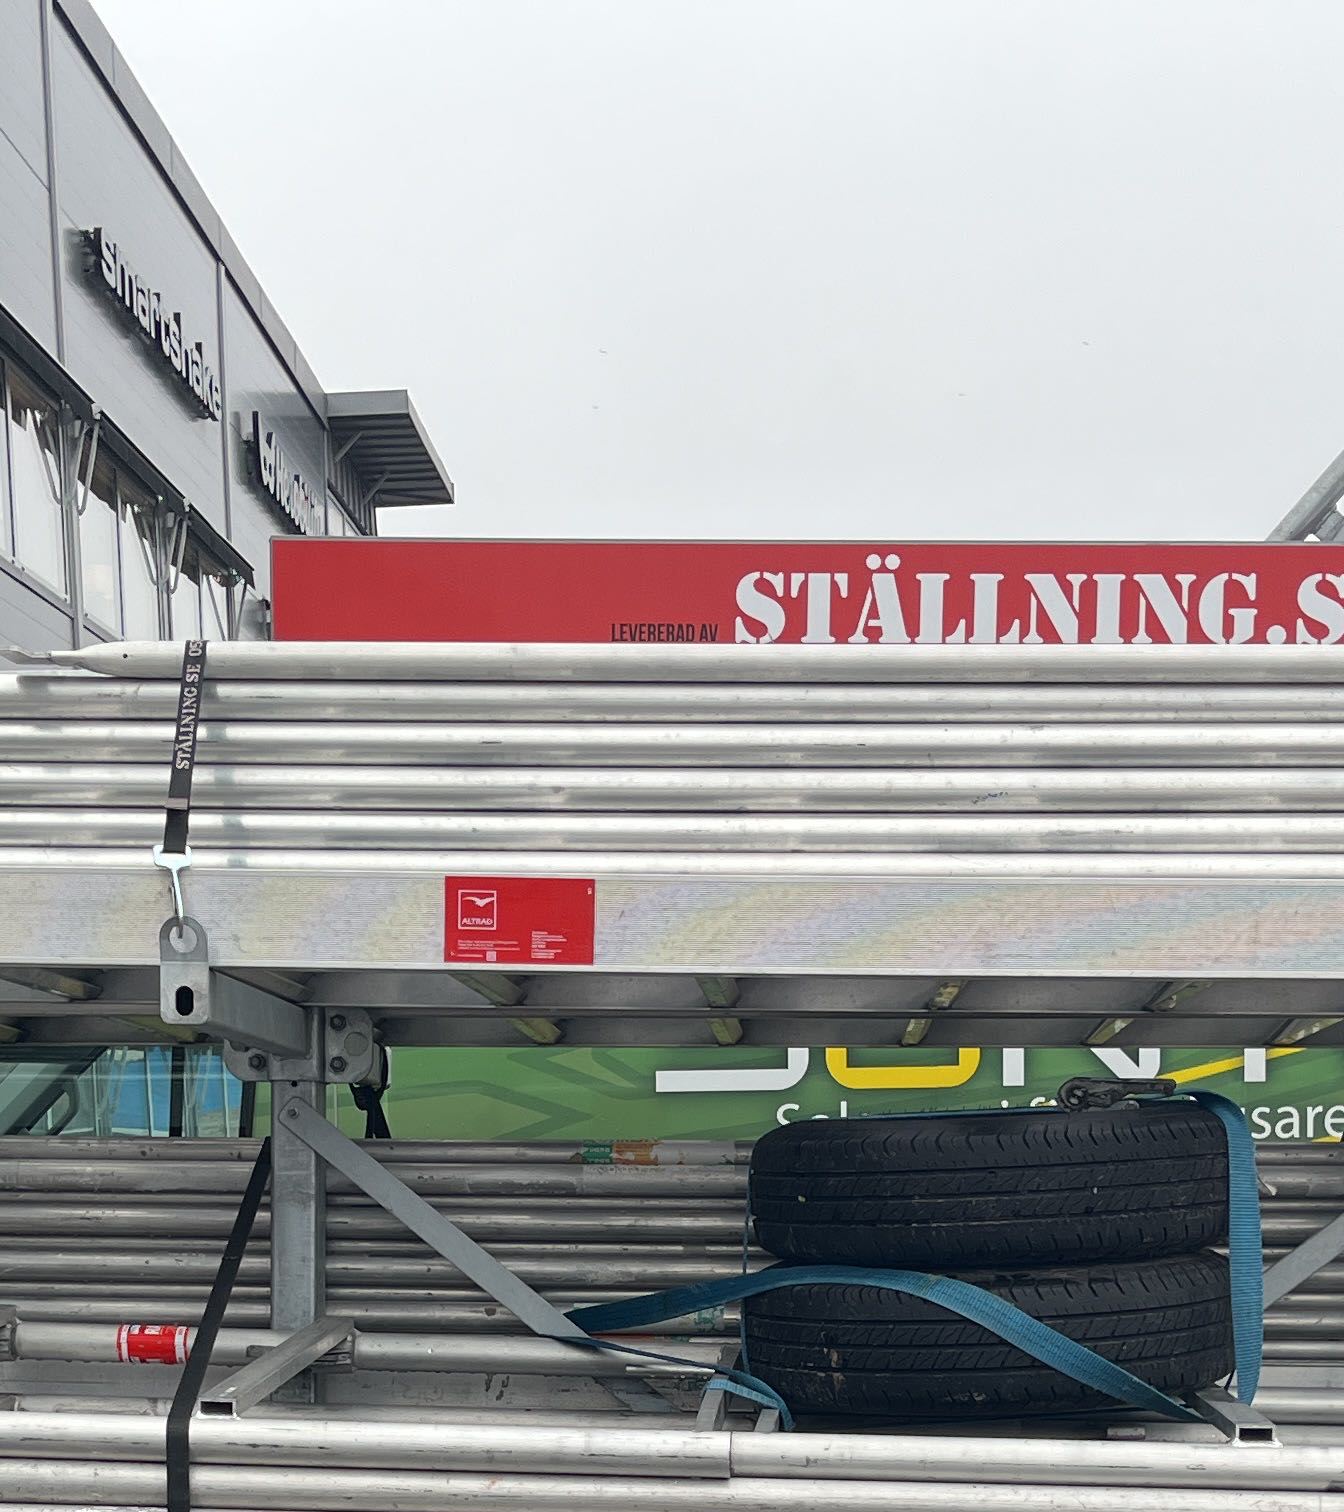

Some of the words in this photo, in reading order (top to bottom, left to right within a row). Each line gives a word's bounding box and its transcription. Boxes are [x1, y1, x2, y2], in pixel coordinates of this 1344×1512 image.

[611, 622, 695, 642] LEVERERAD
[698, 622, 719, 642] AV
[174, 663, 201, 770] STÄLLNING.SE
[461, 917, 494, 926] ALTRAD
